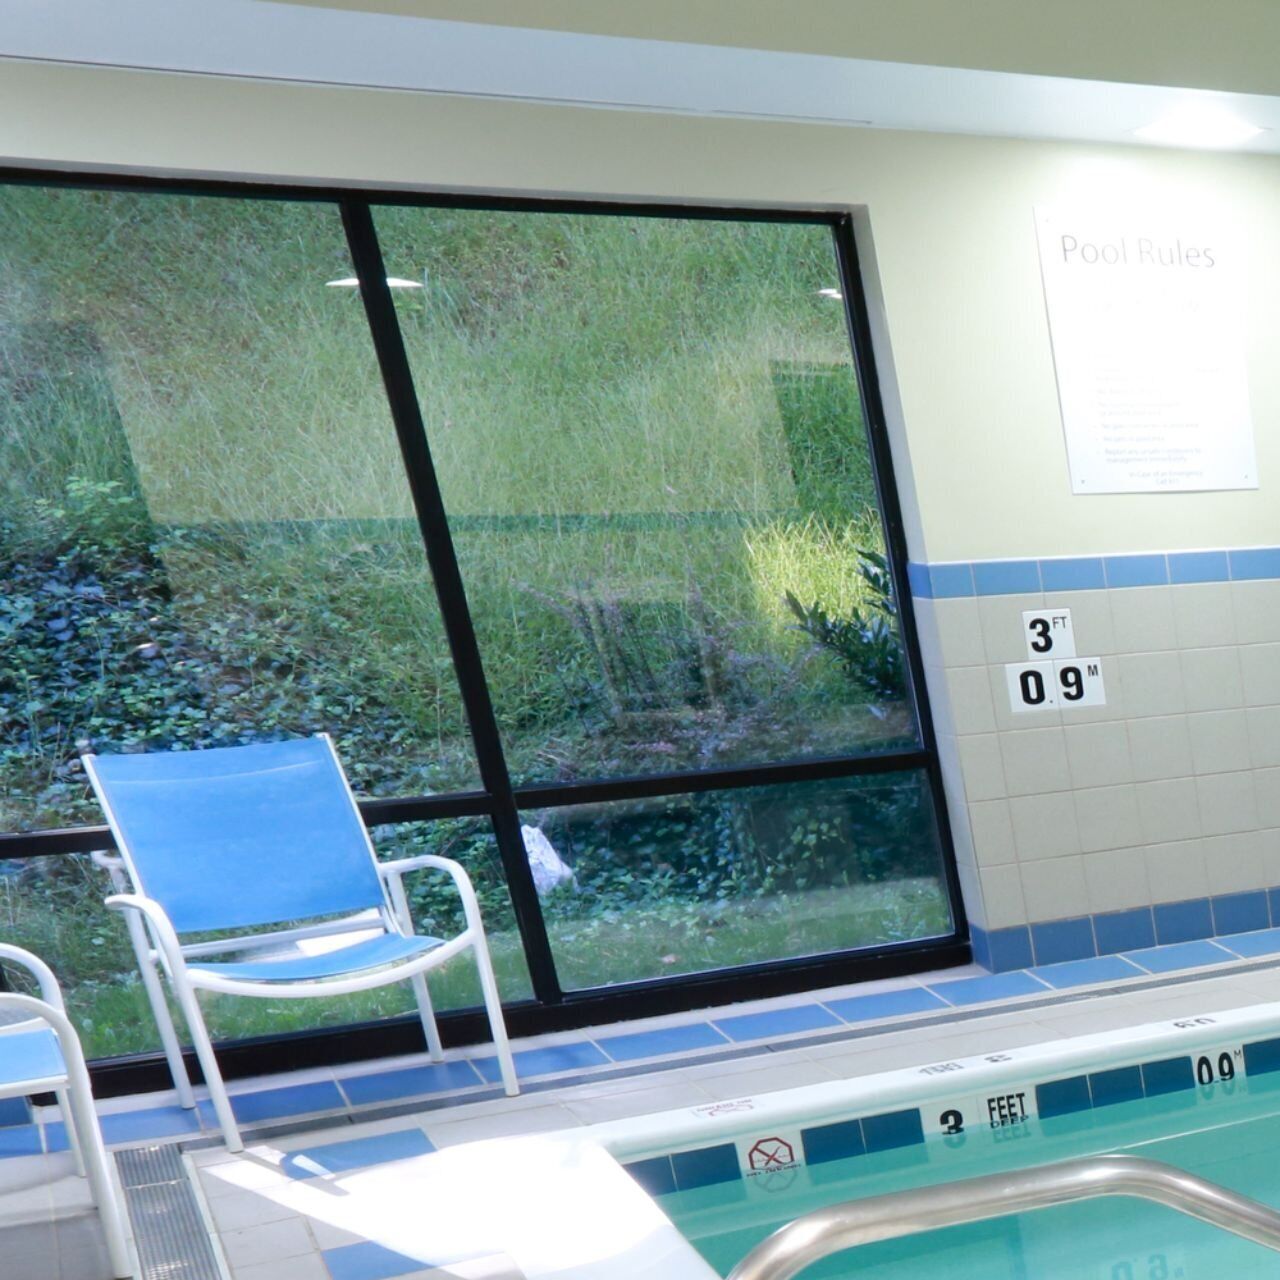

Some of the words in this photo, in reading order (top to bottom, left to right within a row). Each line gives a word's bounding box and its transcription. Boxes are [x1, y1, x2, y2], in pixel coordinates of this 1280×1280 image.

[1061, 234, 1127, 265] Pool
[1138, 237, 1215, 268] Rules
[987, 1092, 1026, 1122] FEET
